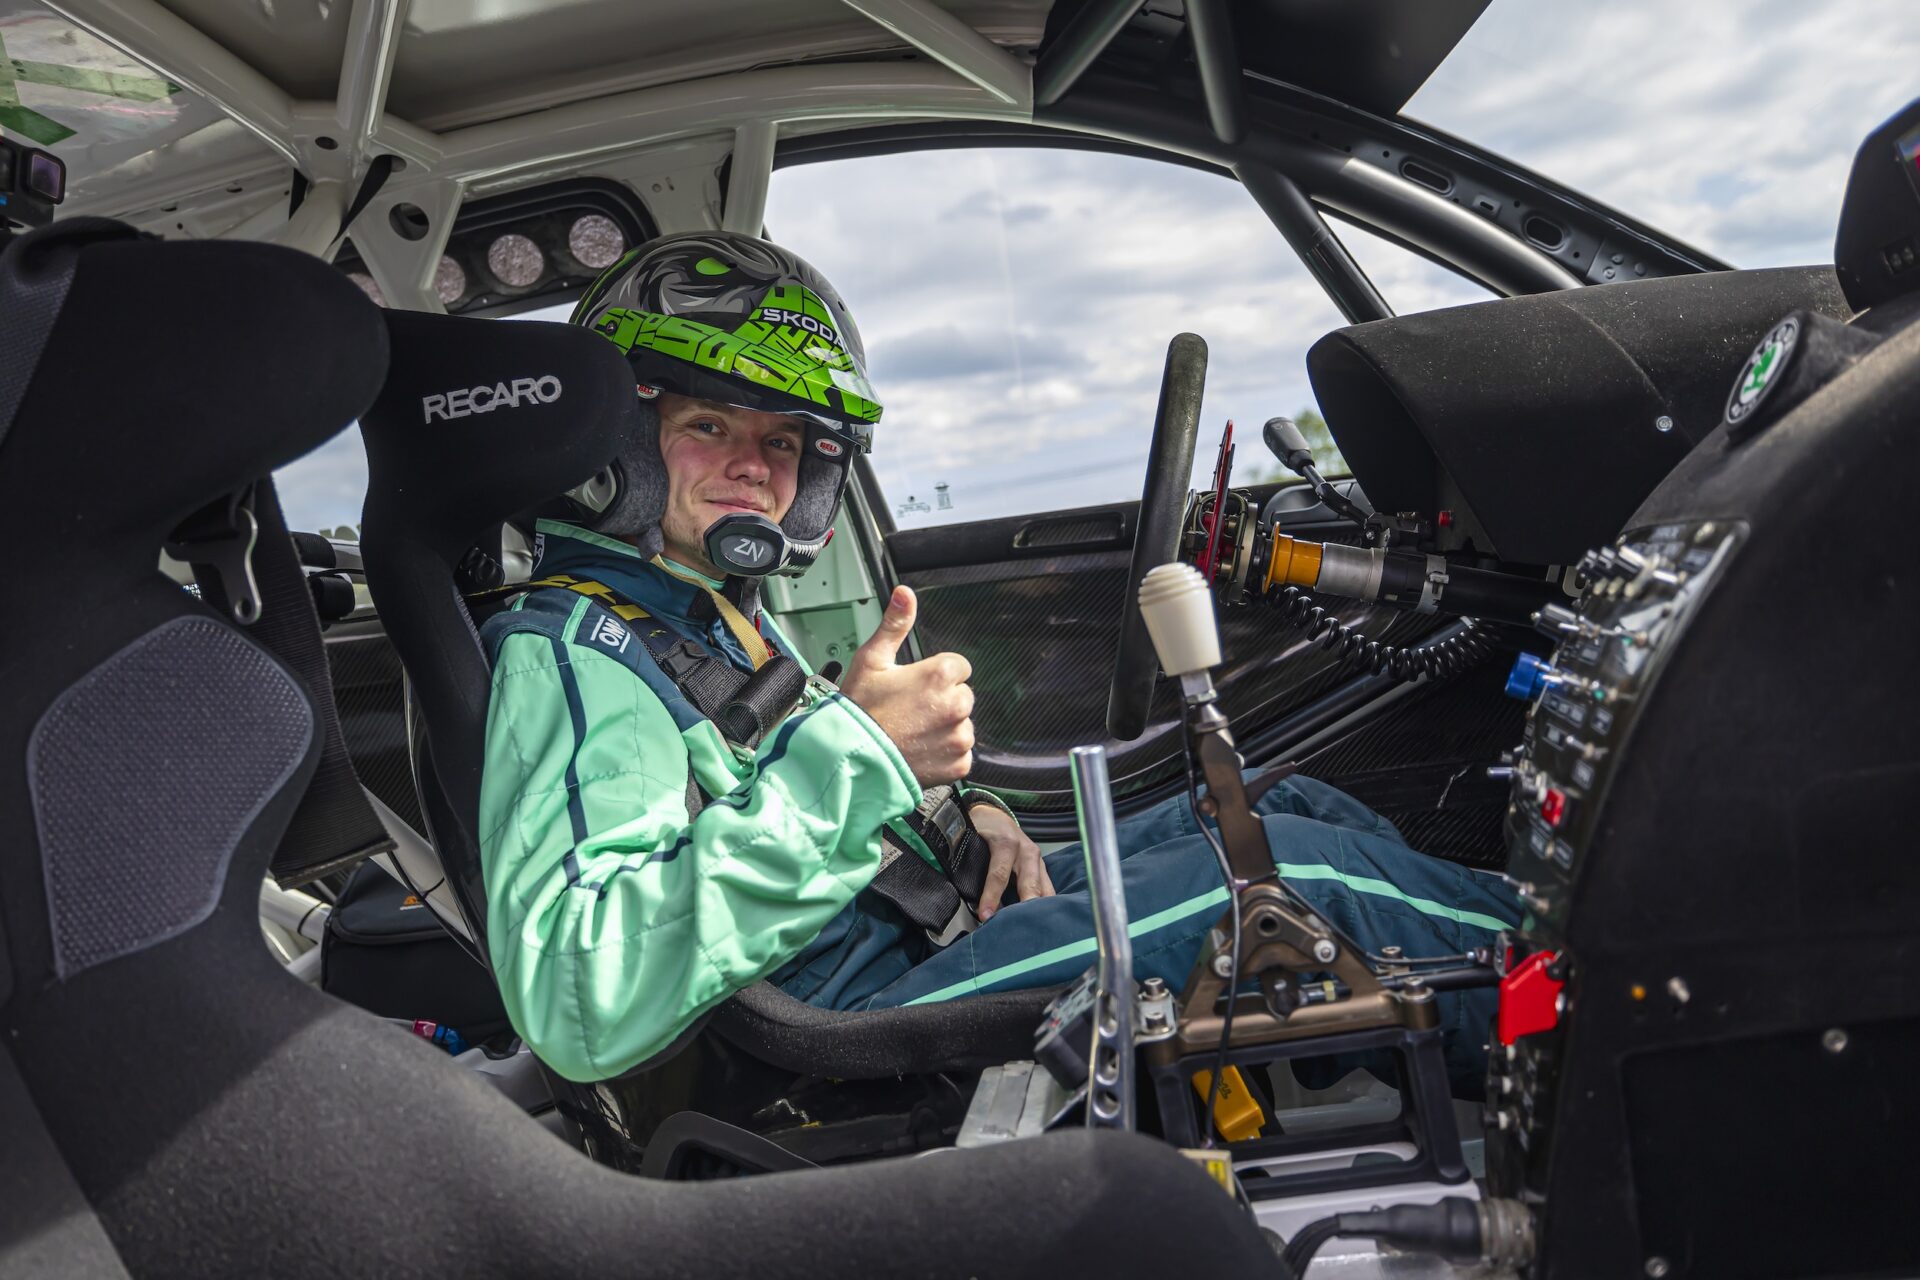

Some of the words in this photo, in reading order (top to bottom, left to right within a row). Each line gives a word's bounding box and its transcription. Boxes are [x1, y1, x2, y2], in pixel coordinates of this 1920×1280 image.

[422, 374, 562, 424] RECARO
[819, 441, 837, 453] BELL
[598, 617, 626, 647] OMP
